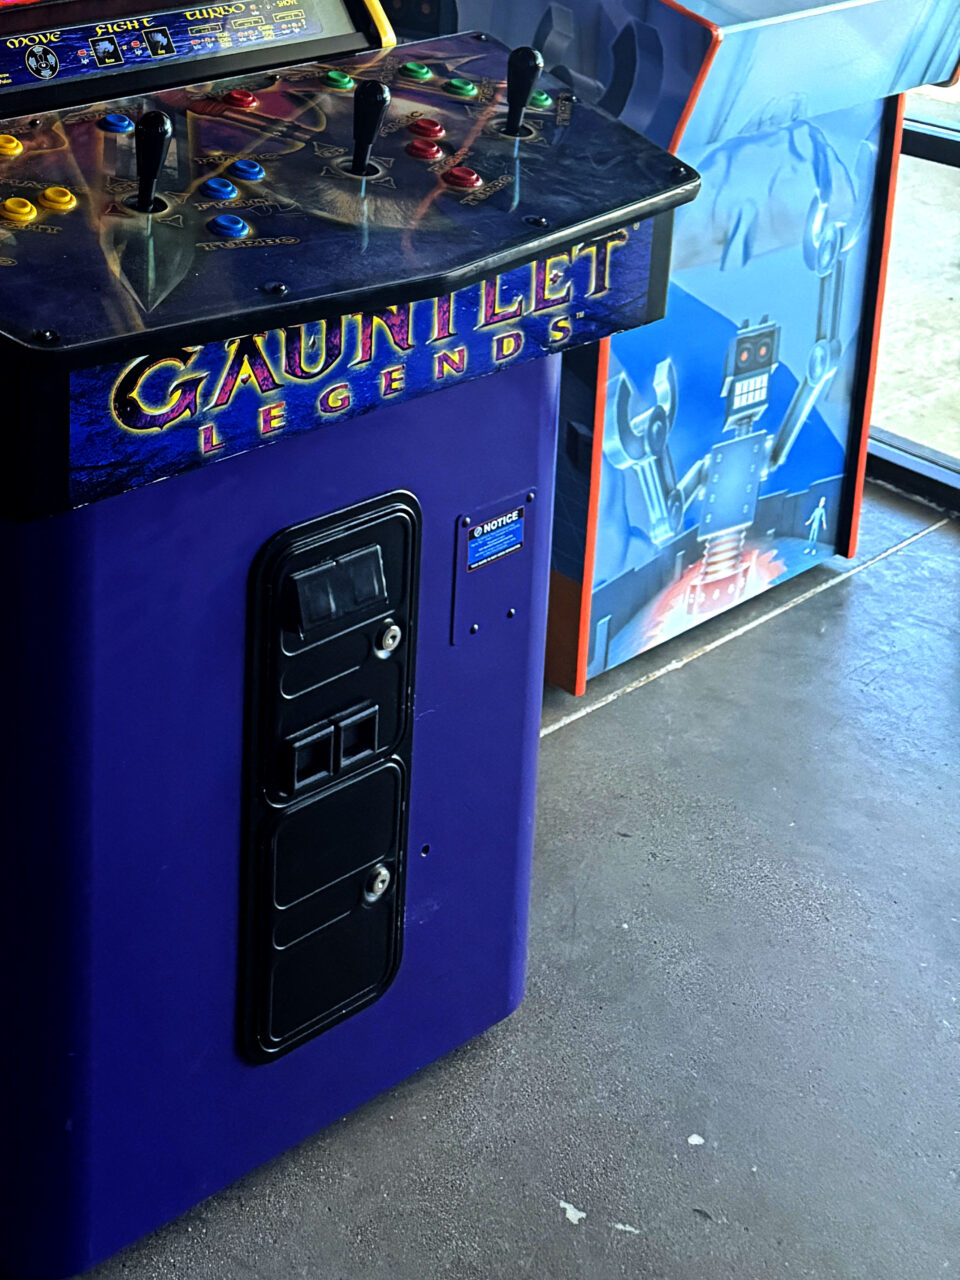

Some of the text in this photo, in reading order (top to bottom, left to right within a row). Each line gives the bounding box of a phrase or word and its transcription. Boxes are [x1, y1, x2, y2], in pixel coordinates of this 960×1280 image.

[184, 2, 246, 22] TURBO
[95, 17, 155, 37] FIGHT
[6, 31, 61, 49] MOVE
[111, 228, 628, 433] GAUNTLET
[200, 314, 574, 457] LEGENDS
[483, 510, 519, 534] NOTICE
